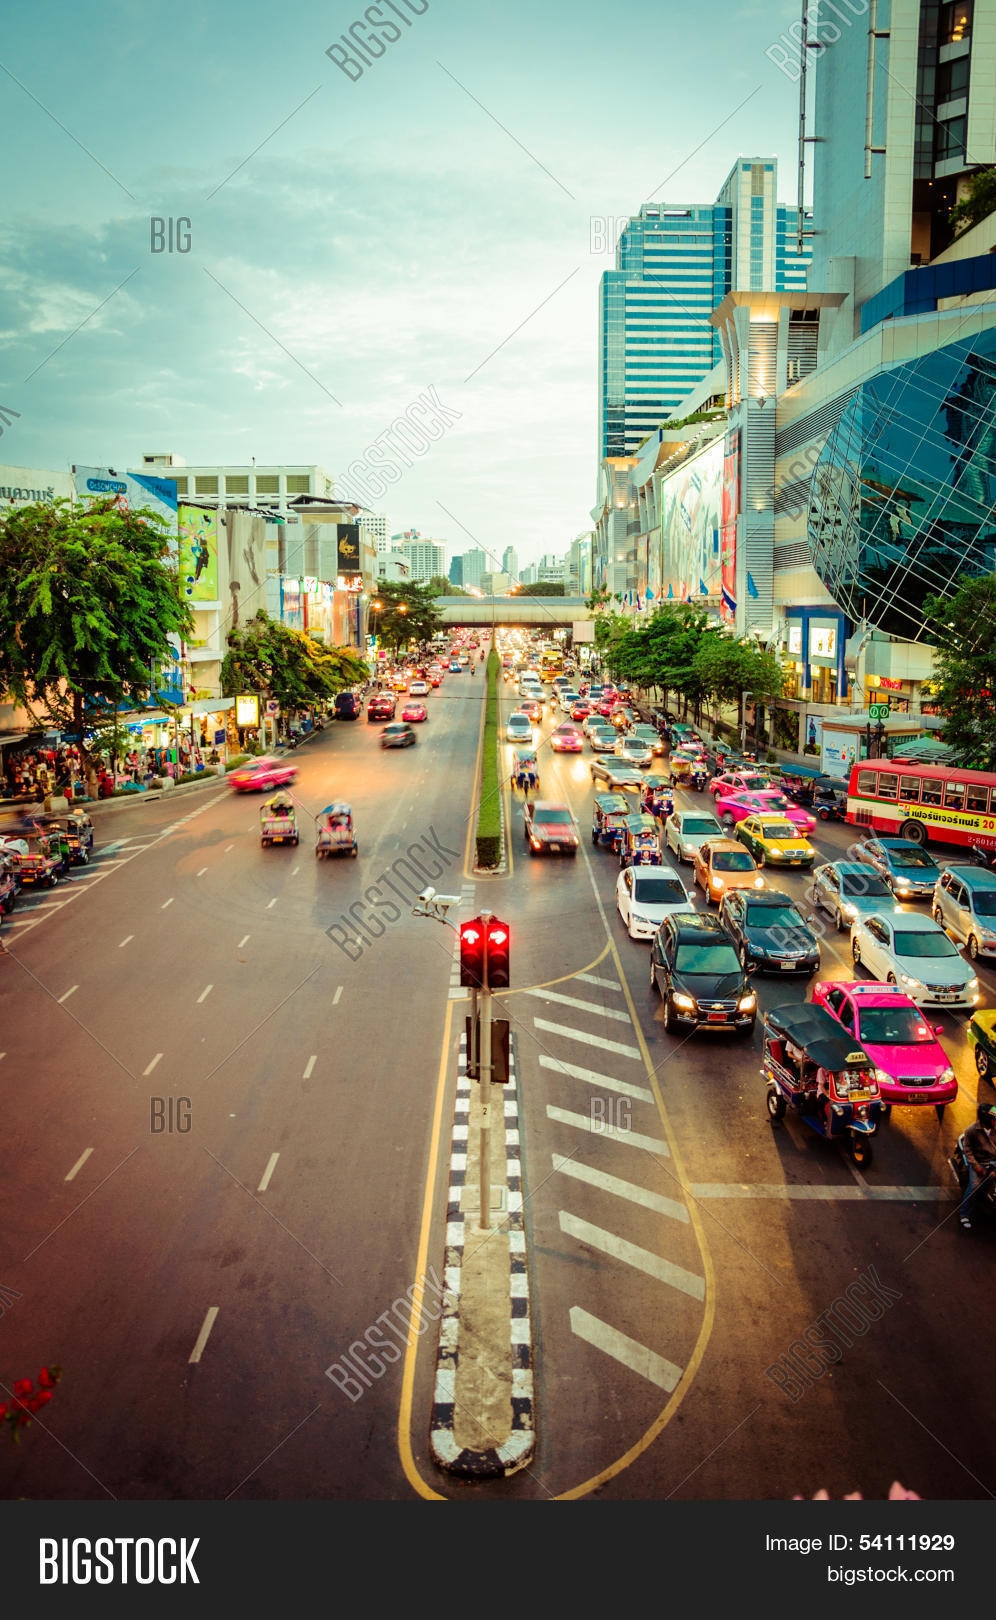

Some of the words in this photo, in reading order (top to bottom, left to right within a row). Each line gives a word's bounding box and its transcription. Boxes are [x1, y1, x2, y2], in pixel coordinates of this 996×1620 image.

[0, 486, 55, 505] นความรู้
[982, 819, 995, 830] 20
